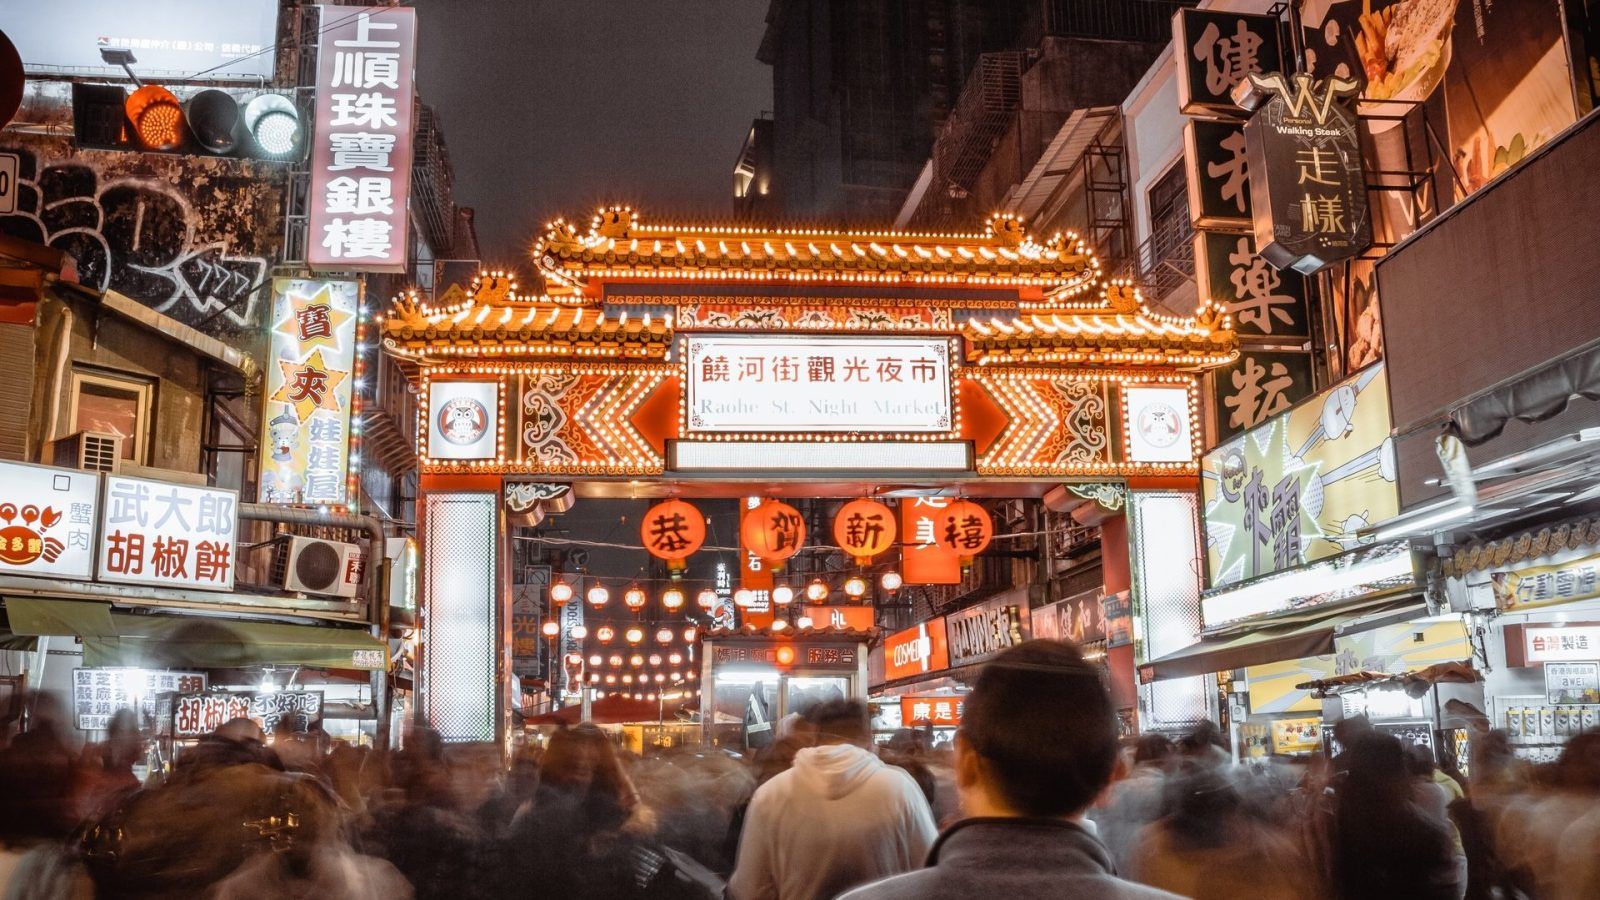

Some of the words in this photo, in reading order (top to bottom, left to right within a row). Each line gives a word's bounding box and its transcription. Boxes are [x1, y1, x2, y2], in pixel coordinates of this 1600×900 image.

[322, 13, 400, 259] 上順珠寶銀樓
[1276, 126, 1314, 137] Walking
[1315, 127, 1341, 136] Steak
[1295, 147, 1346, 233] 走樣
[701, 355, 938, 384] 饒河街觀光夜市
[701, 399, 759, 415] Raohe
[771, 399, 796, 415] St.
[808, 398, 858, 416] Night
[873, 398, 941, 415] Market
[305, 417, 343, 501] 娃娃屋
[67, 502, 93, 552] 蟹肉
[109, 483, 233, 536] 武大郎
[651, 513, 692, 551] 恭
[846, 512, 884, 549] 新
[944, 515, 985, 550] 禧
[106, 529, 231, 584] 胡椒餅
[807, 648, 854, 665] 服務台
[1532, 636, 1589, 652] 台灣製造
[255, 694, 319, 714] 不好吃
